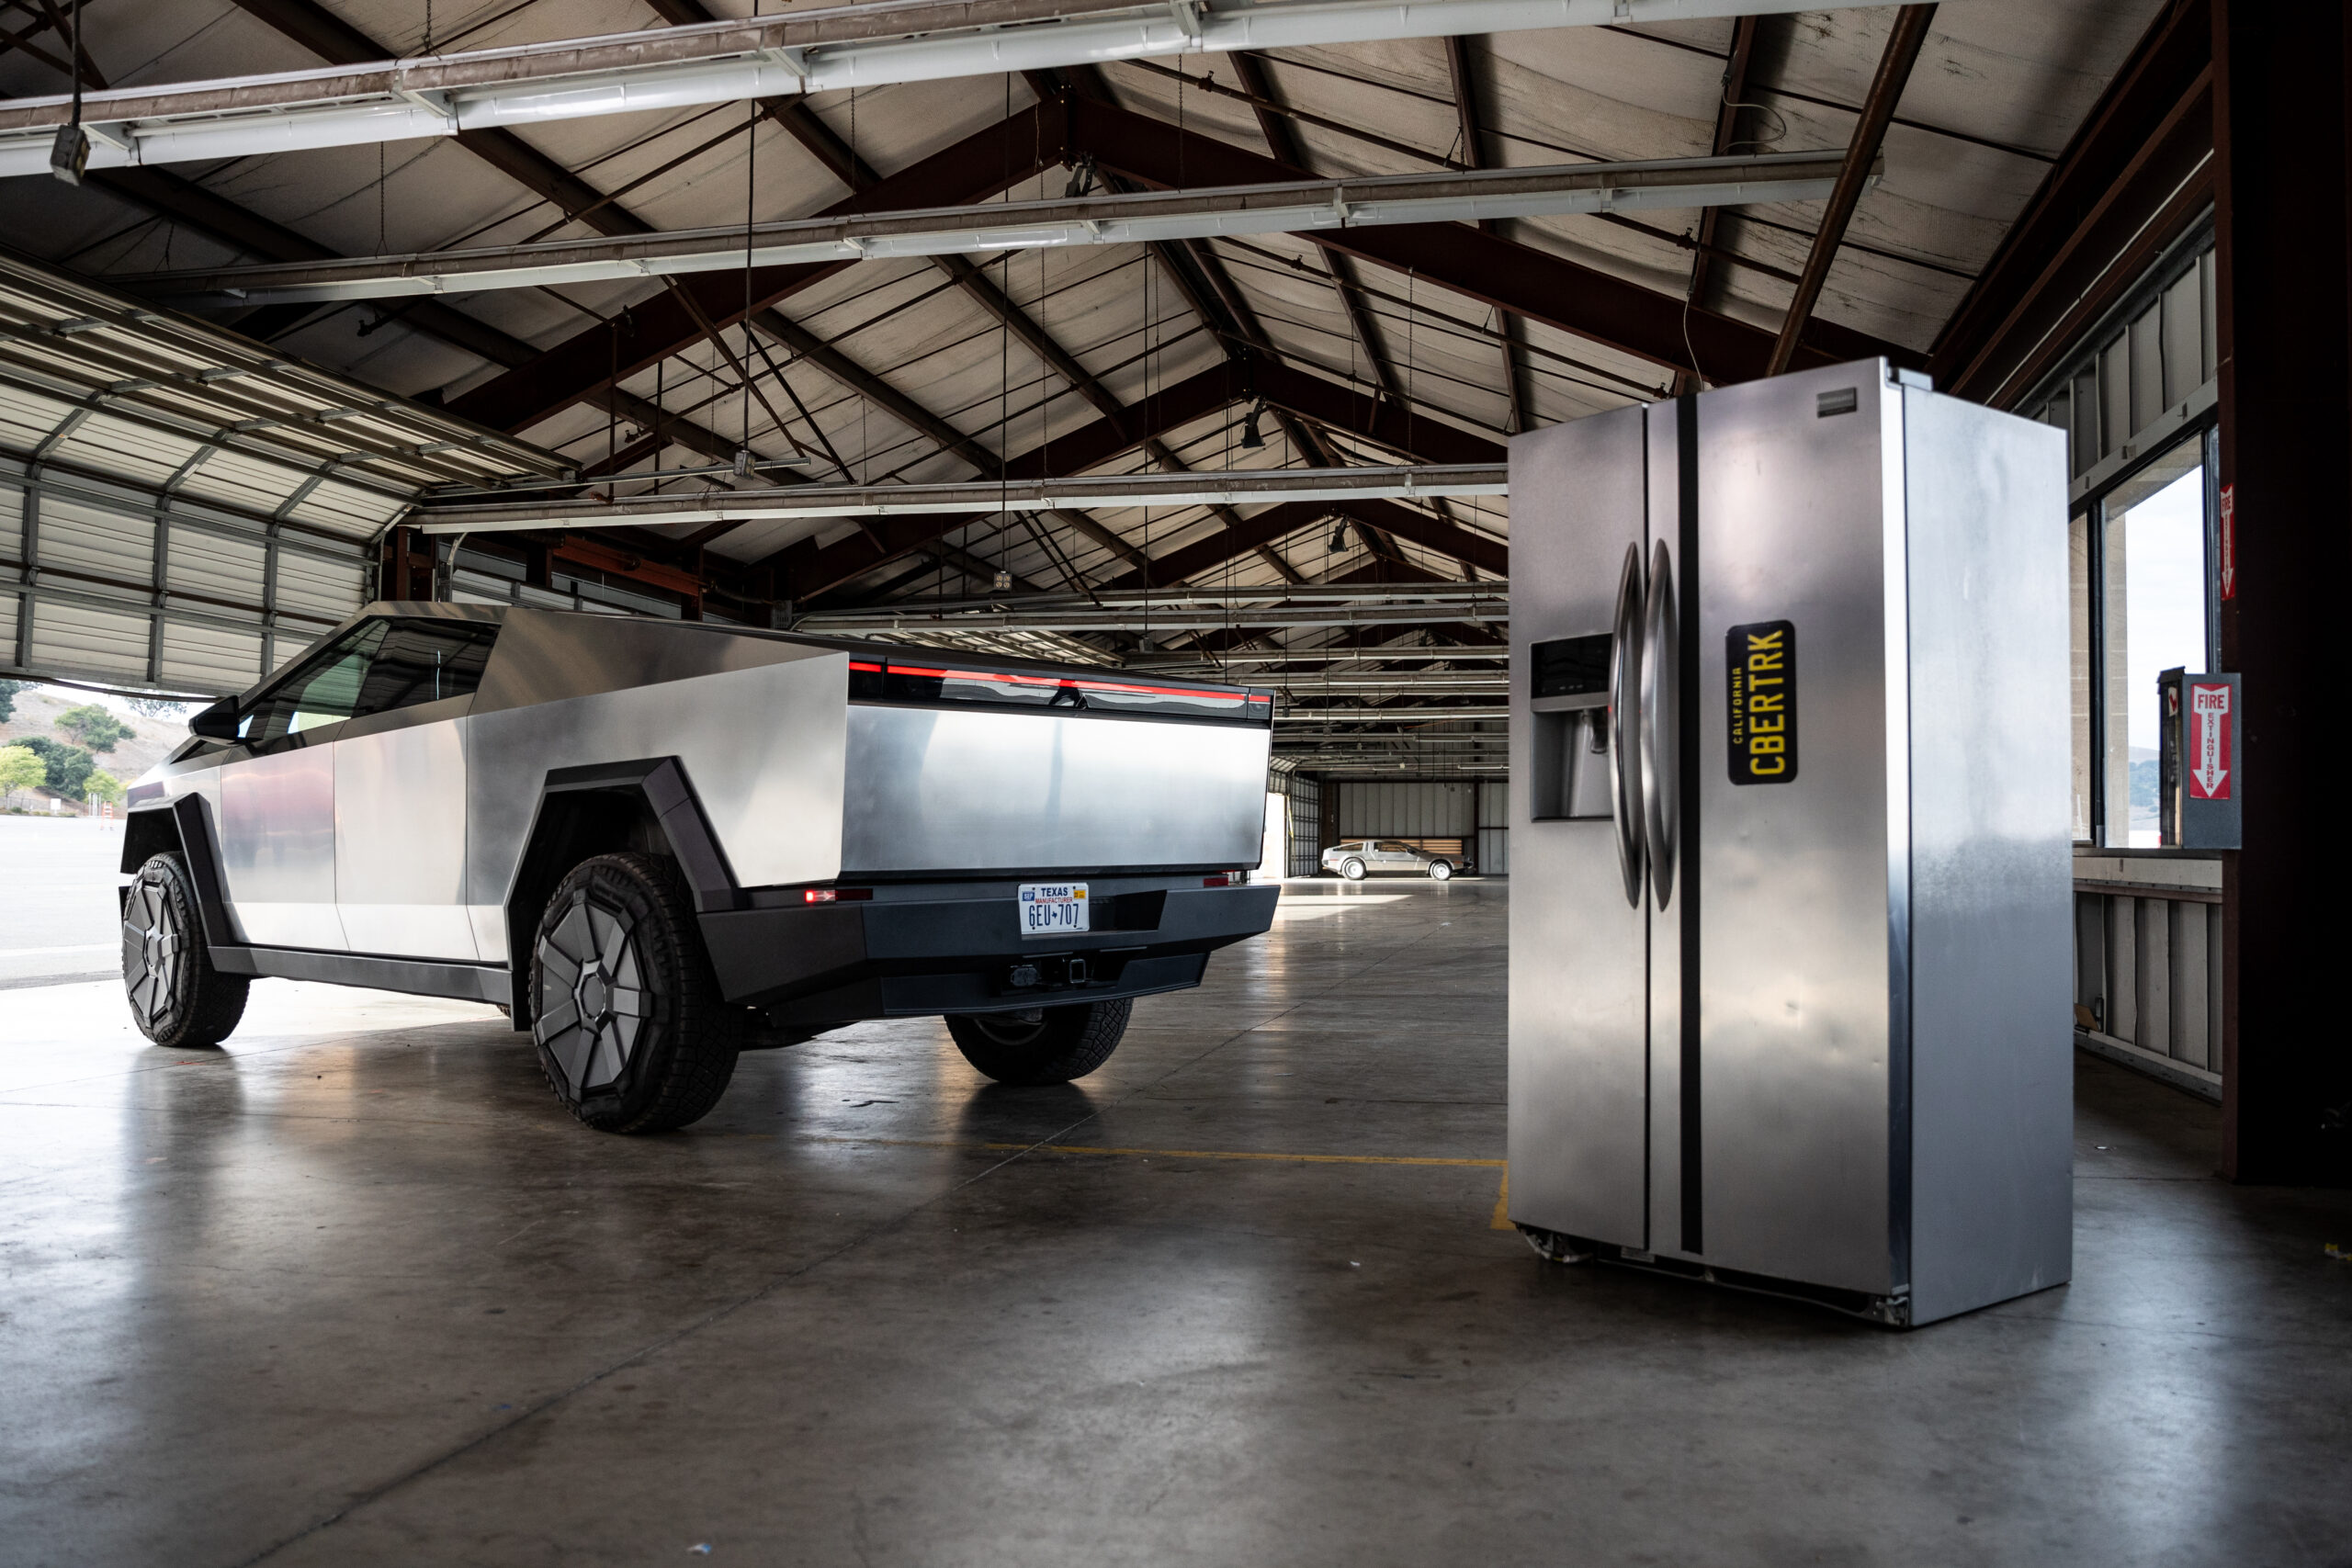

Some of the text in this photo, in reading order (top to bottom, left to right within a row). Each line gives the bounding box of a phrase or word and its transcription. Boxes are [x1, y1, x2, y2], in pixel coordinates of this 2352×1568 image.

[1732, 667, 1744, 745] CALIFORNIA
[1747, 629, 1786, 776] CBERTRK
[2197, 694, 2225, 710] FIRE
[2206, 712, 2215, 789] EXTINGUISHER
[1029, 903, 1079, 927] 6EU 707
[1041, 887, 1069, 897] TEXAS
